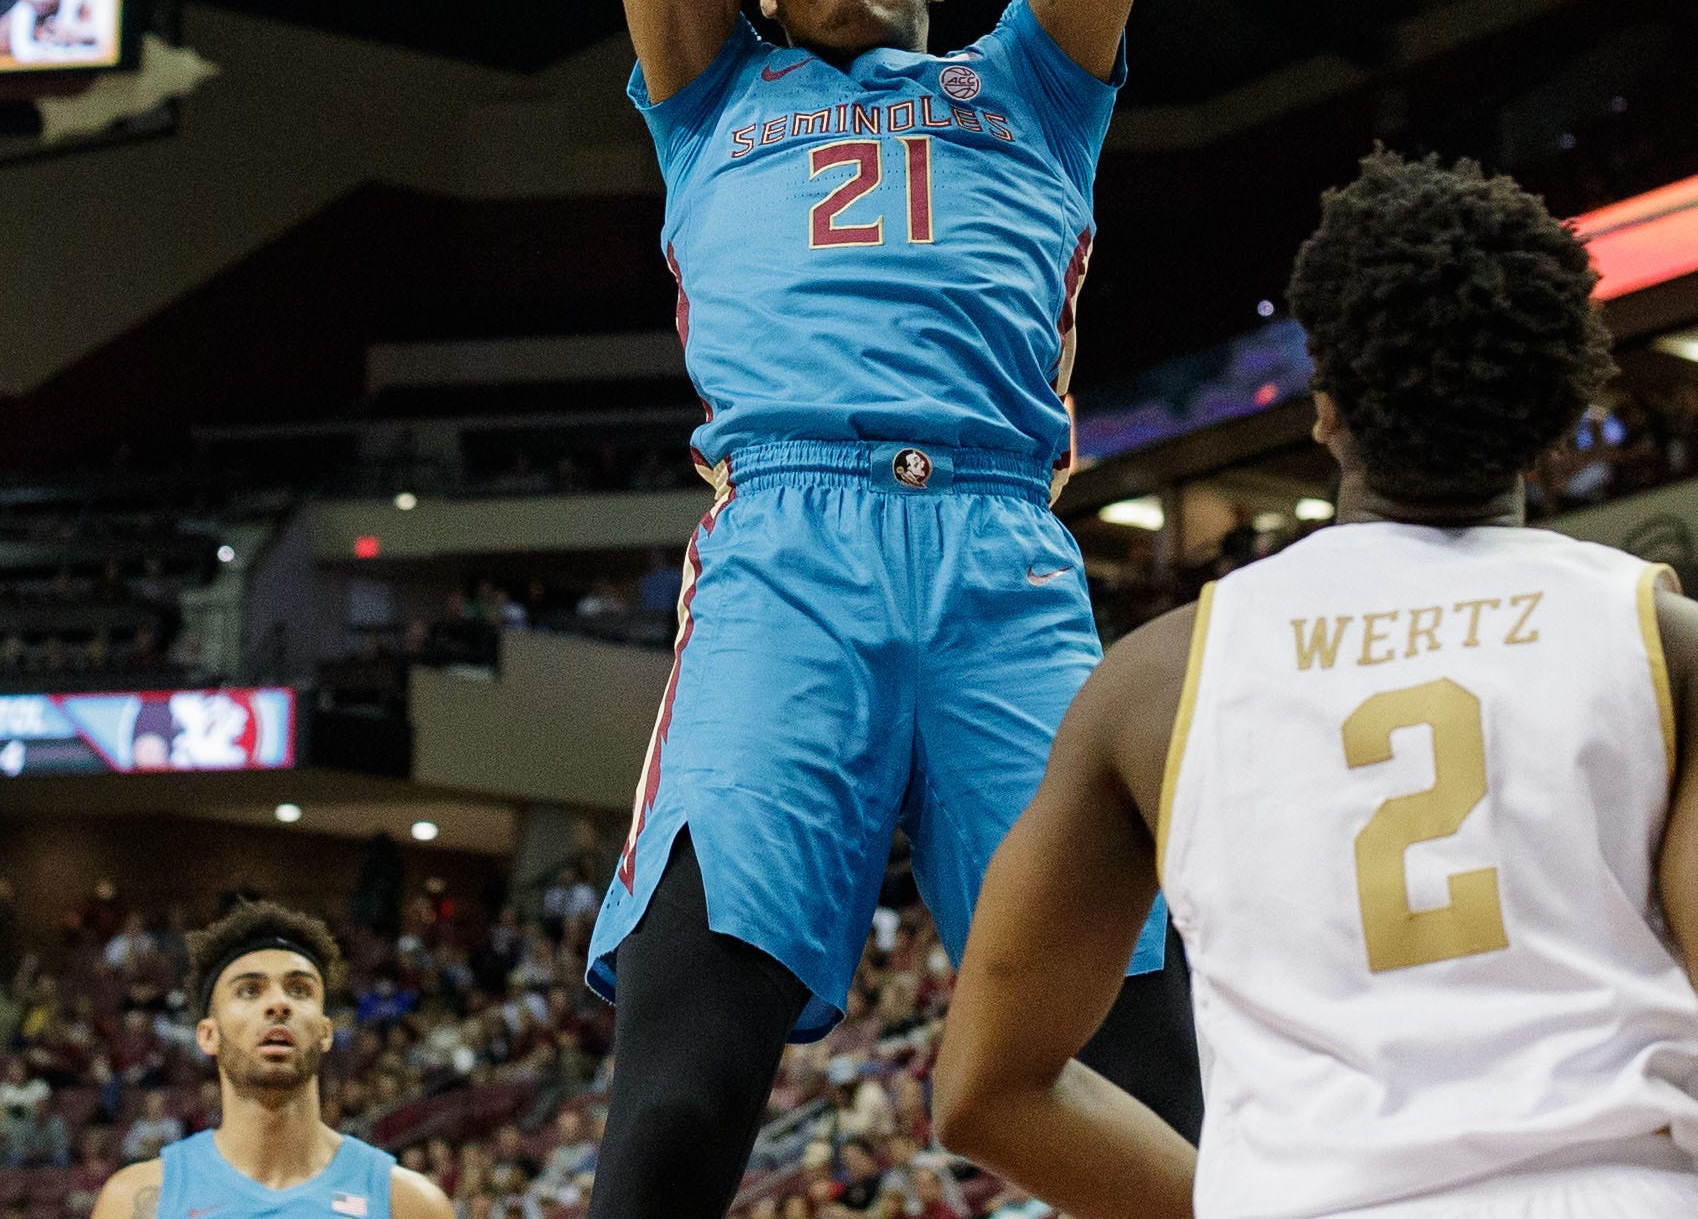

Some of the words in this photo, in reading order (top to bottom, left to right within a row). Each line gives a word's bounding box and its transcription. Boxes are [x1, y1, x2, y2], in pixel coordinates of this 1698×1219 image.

[946, 76, 976, 85] ACC
[730, 95, 1016, 159] SEMINOLES
[808, 135, 935, 250] 21
[1290, 591, 1543, 671] WERTZ
[1340, 677, 1509, 975] 2
